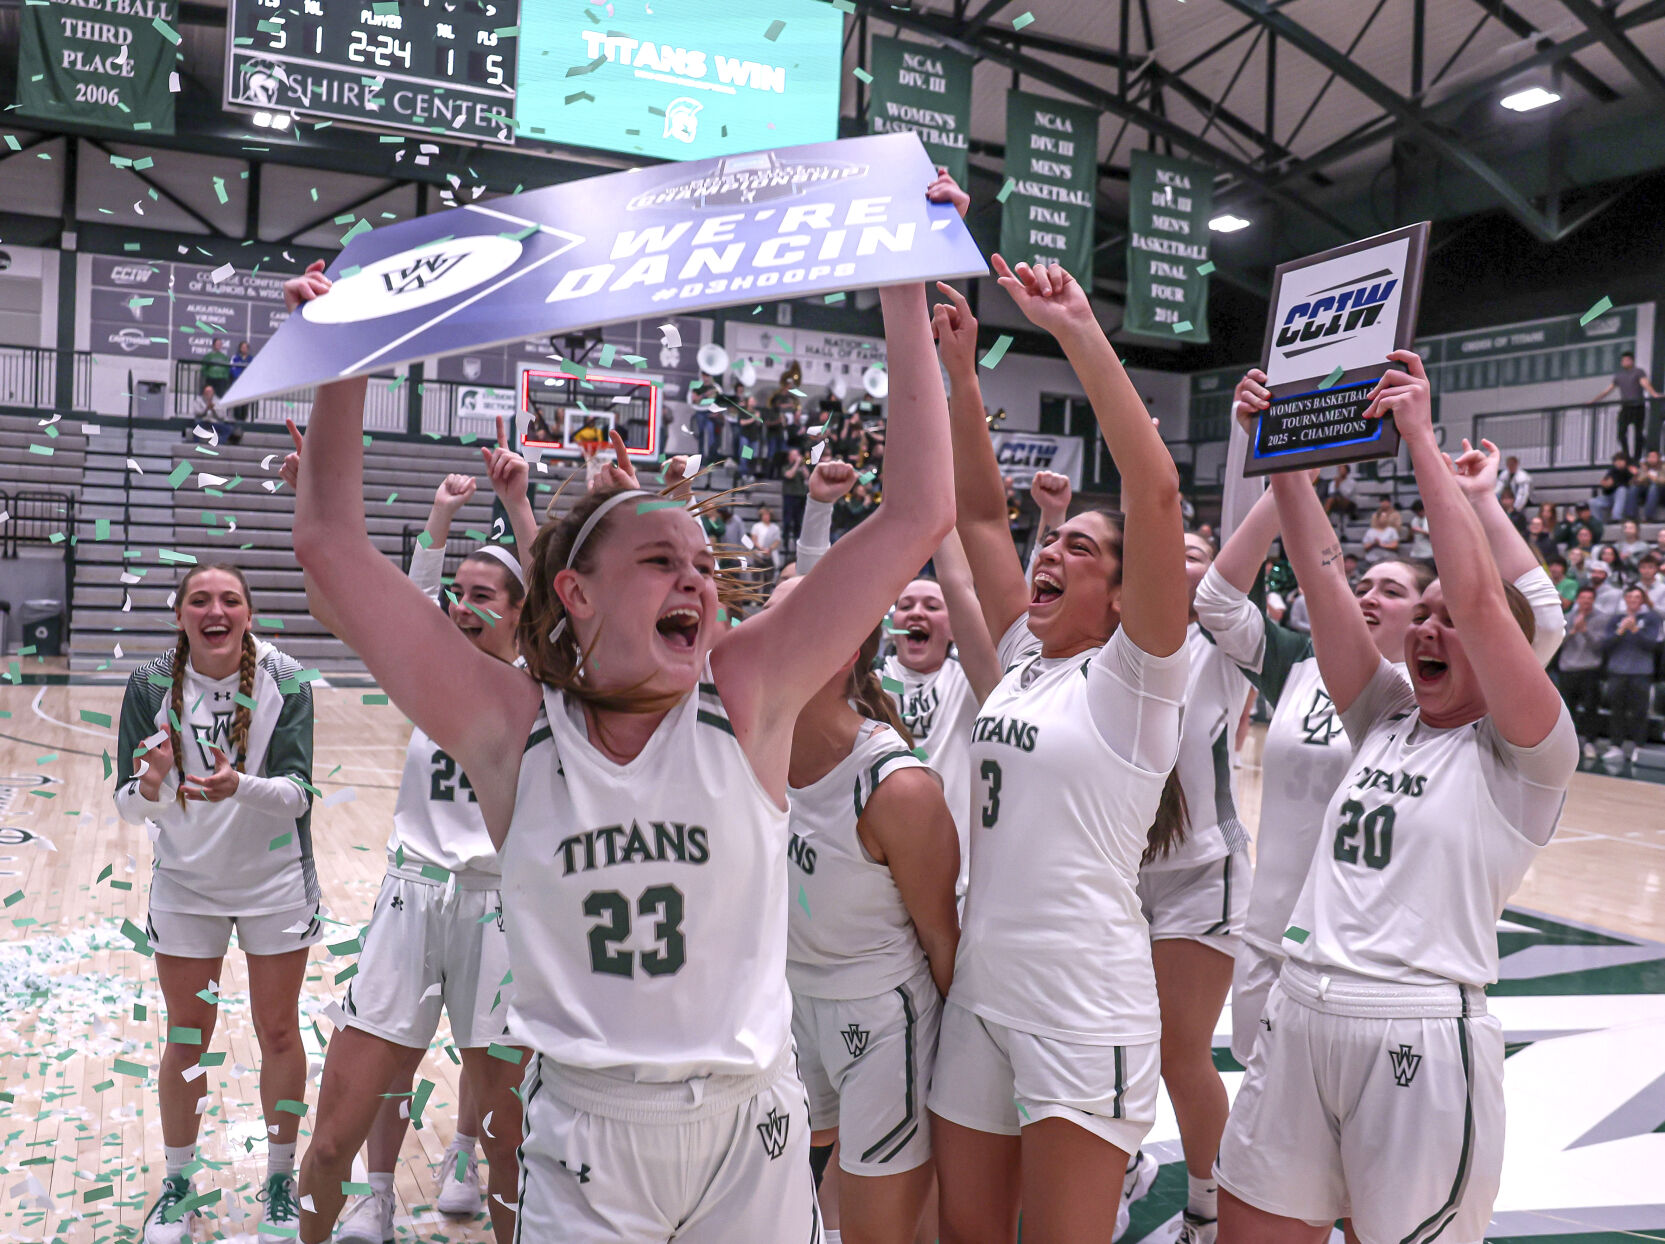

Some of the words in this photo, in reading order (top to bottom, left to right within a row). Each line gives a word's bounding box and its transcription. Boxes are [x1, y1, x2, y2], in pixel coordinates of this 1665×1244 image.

[61, 17, 133, 45] THIRD
[315, 25, 323, 54] 1
[61, 49, 135, 78] PLACE
[348, 30, 412, 69] 2-24
[447, 48, 455, 76] 1
[581, 30, 707, 79] TITANS
[714, 54, 786, 94] WIN
[486, 54, 504, 85] 5
[903, 52, 944, 76] NCAA
[75, 83, 120, 107] 2006
[899, 68, 926, 89] DIV.
[929, 76, 946, 94] III
[393, 90, 508, 129] CENTER
[886, 101, 956, 130] WOMEN'S
[1034, 111, 1073, 134] NCAA
[874, 116, 968, 149] BASKTBALL
[1030, 134, 1057, 153] DIV.
[1058, 140, 1075, 157] III
[1030, 158, 1073, 180] MEN'S
[1155, 169, 1192, 190] NCAA
[1029, 206, 1070, 227] FINAL
[1177, 197, 1193, 213] III
[609, 195, 893, 260] WE'RE
[1152, 214, 1190, 235] MEN'S
[1029, 229, 1067, 250] FOUR
[1131, 232, 1208, 261] BASKETBALL
[111, 265, 153, 283] CCIW
[547, 219, 952, 303] DANCIN'
[1150, 260, 1187, 280] FINAL
[650, 262, 857, 303] #D3HOOPS
[1151, 283, 1184, 302] FOUR
[1275, 278, 1398, 348] CCIW
[1269, 399, 1312, 417] WOMEN'S
[1281, 406, 1357, 430] TOURNAMENT
[1267, 433, 1289, 447] 2025
[1300, 420, 1367, 441] CHAMPIONS
[996, 442, 1059, 468] CCIW
[970, 713, 1040, 754] ITANS
[980, 758, 1003, 830] 3
[554, 818, 711, 878] TITANS
[1333, 798, 1397, 872] 20
[581, 882, 687, 980] 23
